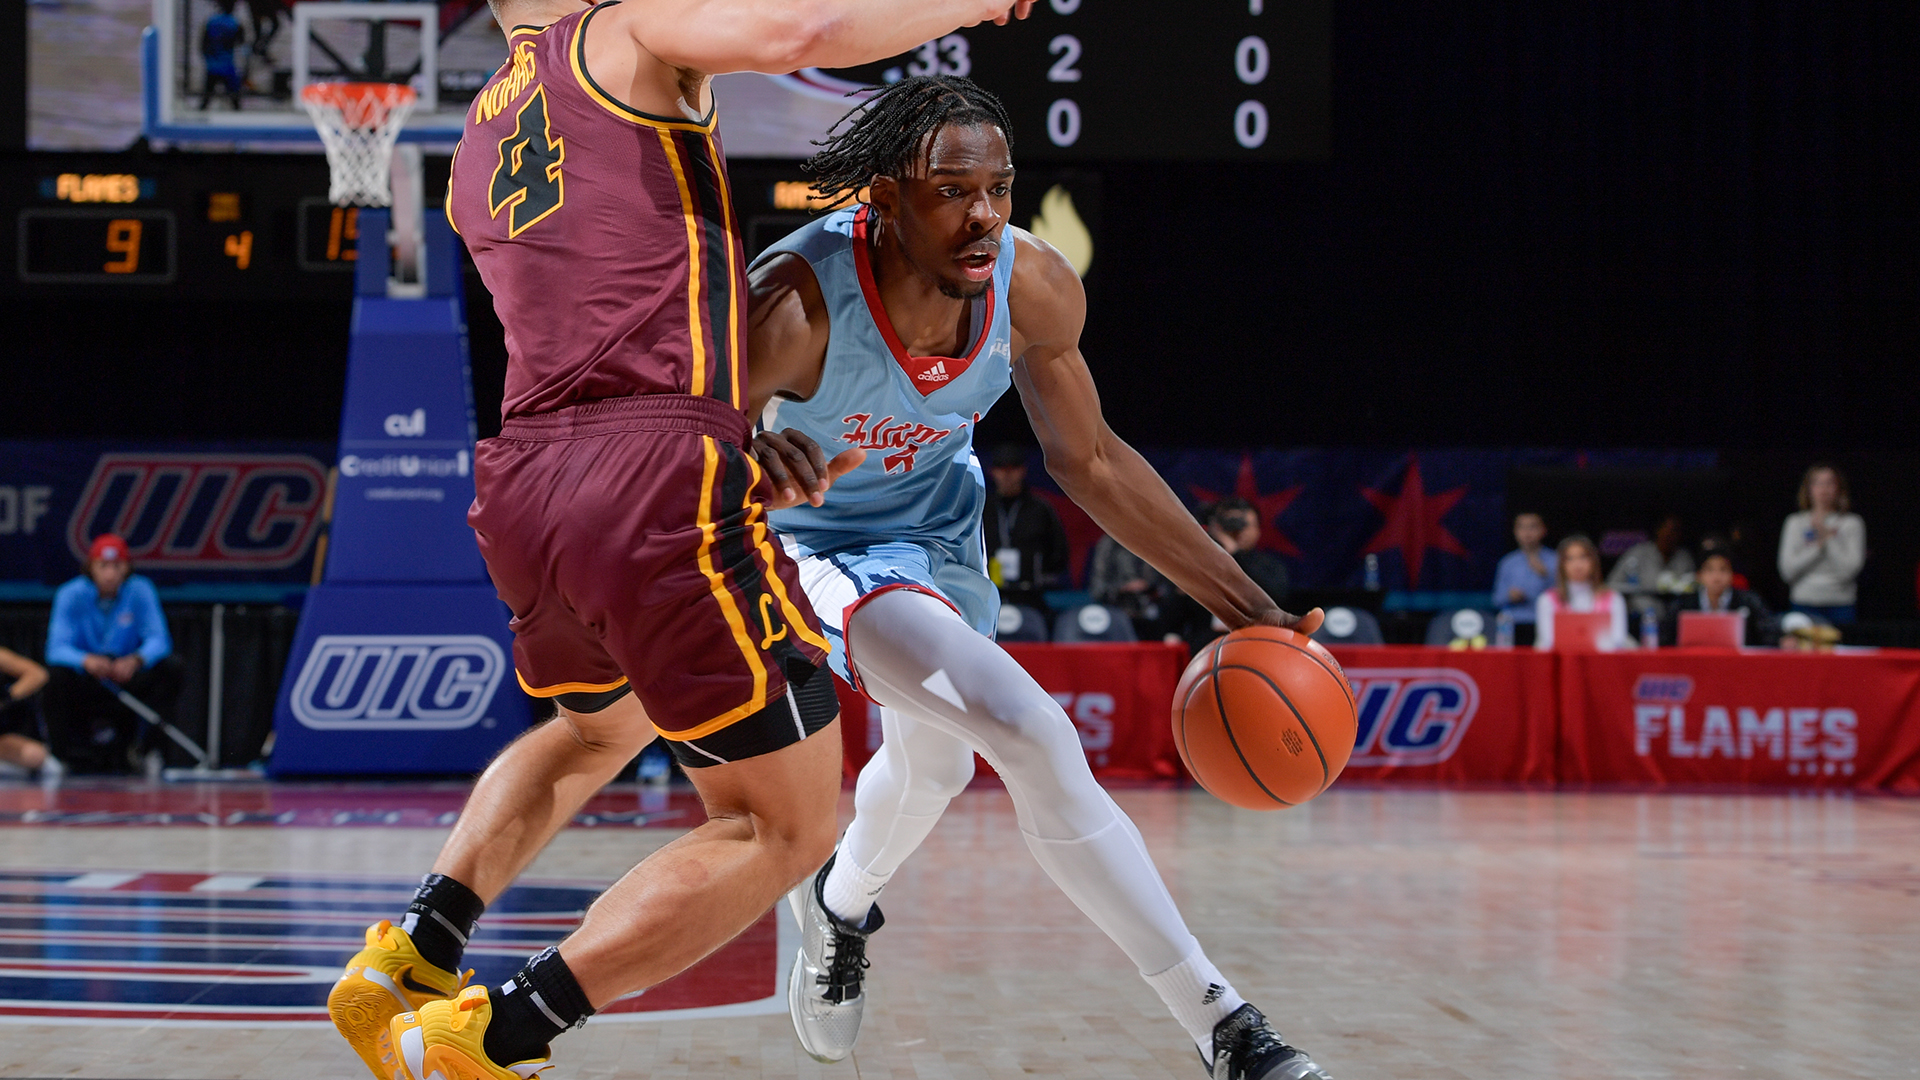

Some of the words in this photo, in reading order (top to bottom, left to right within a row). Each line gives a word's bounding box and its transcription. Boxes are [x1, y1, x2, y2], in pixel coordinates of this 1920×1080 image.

[1047, 36, 1082, 82] 2
[1234, 35, 1270, 84] 0
[1047, 99, 1081, 147] 0
[1233, 100, 1270, 149] 0
[488, 82, 565, 239] 4
[104, 219, 143, 274] 9
[224, 230, 253, 270] 4
[917, 373, 949, 382] adidas
[82, 464, 318, 558] UIC
[300, 643, 495, 722] UIC
[1634, 704, 1858, 761] FLAMES
